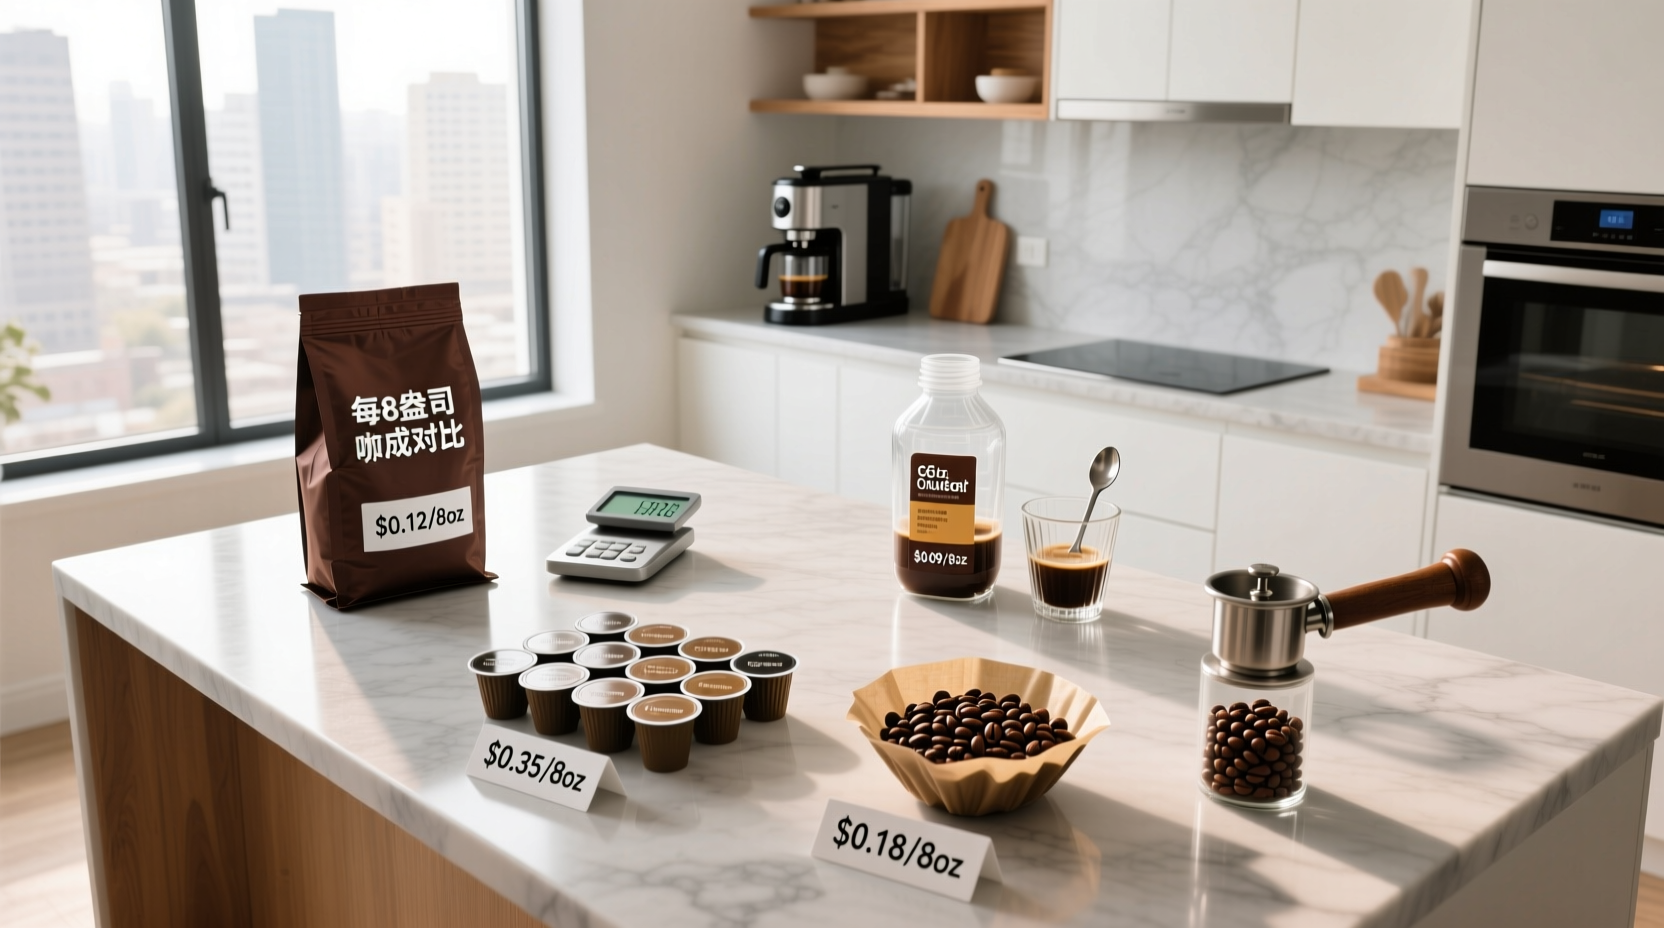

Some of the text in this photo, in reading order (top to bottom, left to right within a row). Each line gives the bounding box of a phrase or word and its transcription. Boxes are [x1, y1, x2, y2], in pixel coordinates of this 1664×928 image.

[375, 506, 465, 539] $0.12/8oz
[483, 739, 587, 793] $0.35/8oz
[832, 815, 964, 879] $0.18/8oz
